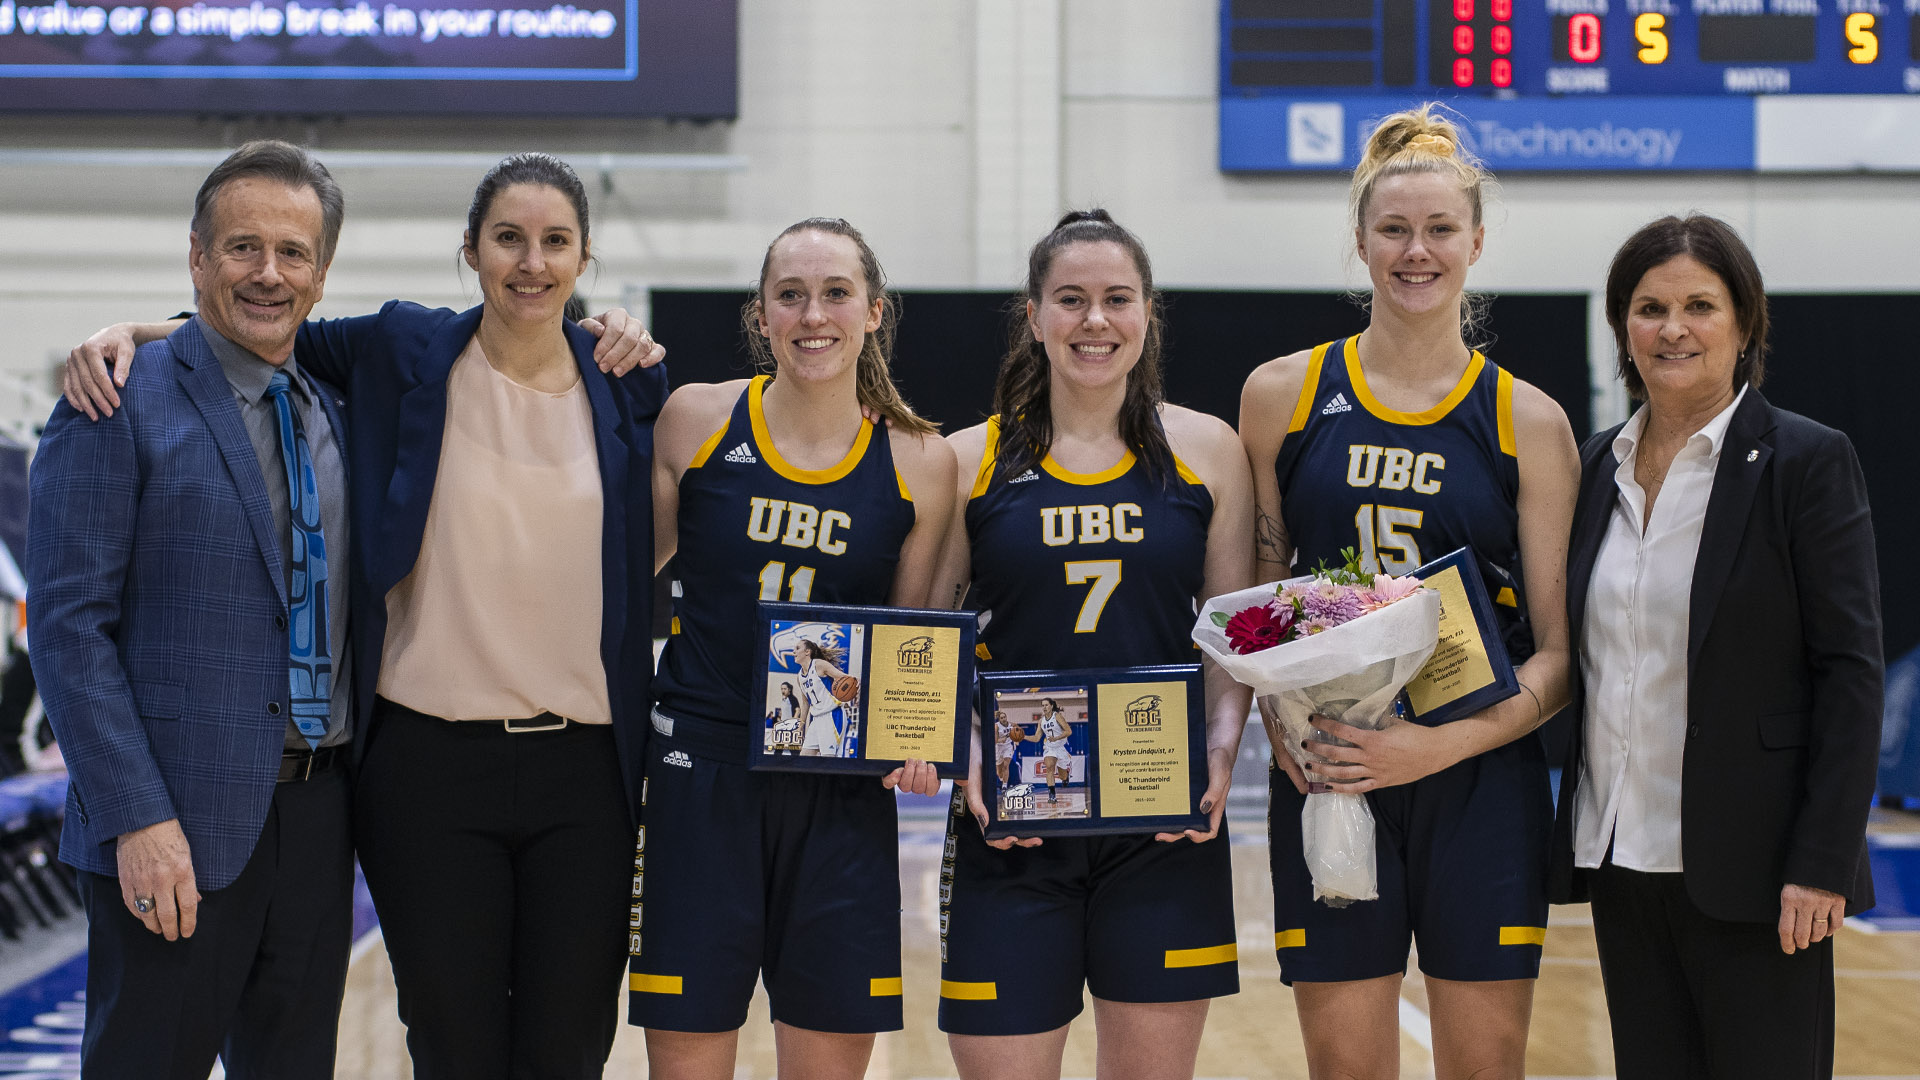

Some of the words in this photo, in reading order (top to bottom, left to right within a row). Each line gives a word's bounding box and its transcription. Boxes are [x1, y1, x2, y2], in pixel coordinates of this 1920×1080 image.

[17, 0, 108, 35] value
[108, 6, 148, 36] or
[150, 6, 176, 36] a
[176, 2, 285, 41] simple
[286, 1, 381, 37] break
[383, 3, 417, 36] in
[419, 9, 497, 43] your
[498, 4, 617, 38] routine
[1453, 25, 1474, 55] 0
[1491, 25, 1512, 55] 0
[1568, 13, 1601, 63] 0
[1635, 12, 1668, 64] 5
[1845, 12, 1879, 64] 5
[1453, 57, 1474, 88] 0
[1491, 57, 1512, 88] 0
[1477, 118, 1682, 165] Technology
[1322, 404, 1352, 415] adidas
[725, 454, 757, 464] adidas
[1346, 444, 1446, 495] UBC
[747, 496, 851, 556] UBC
[1040, 502, 1145, 547] UBC
[1354, 503, 1424, 579] 15
[758, 560, 816, 602] 11
[1064, 559, 1122, 634] 7
[897, 650, 933, 668] UBC
[1435, 656, 1469, 674] Thunderbird
[1433, 667, 1461, 684] Basketball
[1124, 709, 1162, 727] UBC
[772, 730, 803, 745] UBC
[663, 756, 692, 768] adidas
[1003, 796, 1035, 810] UBC
